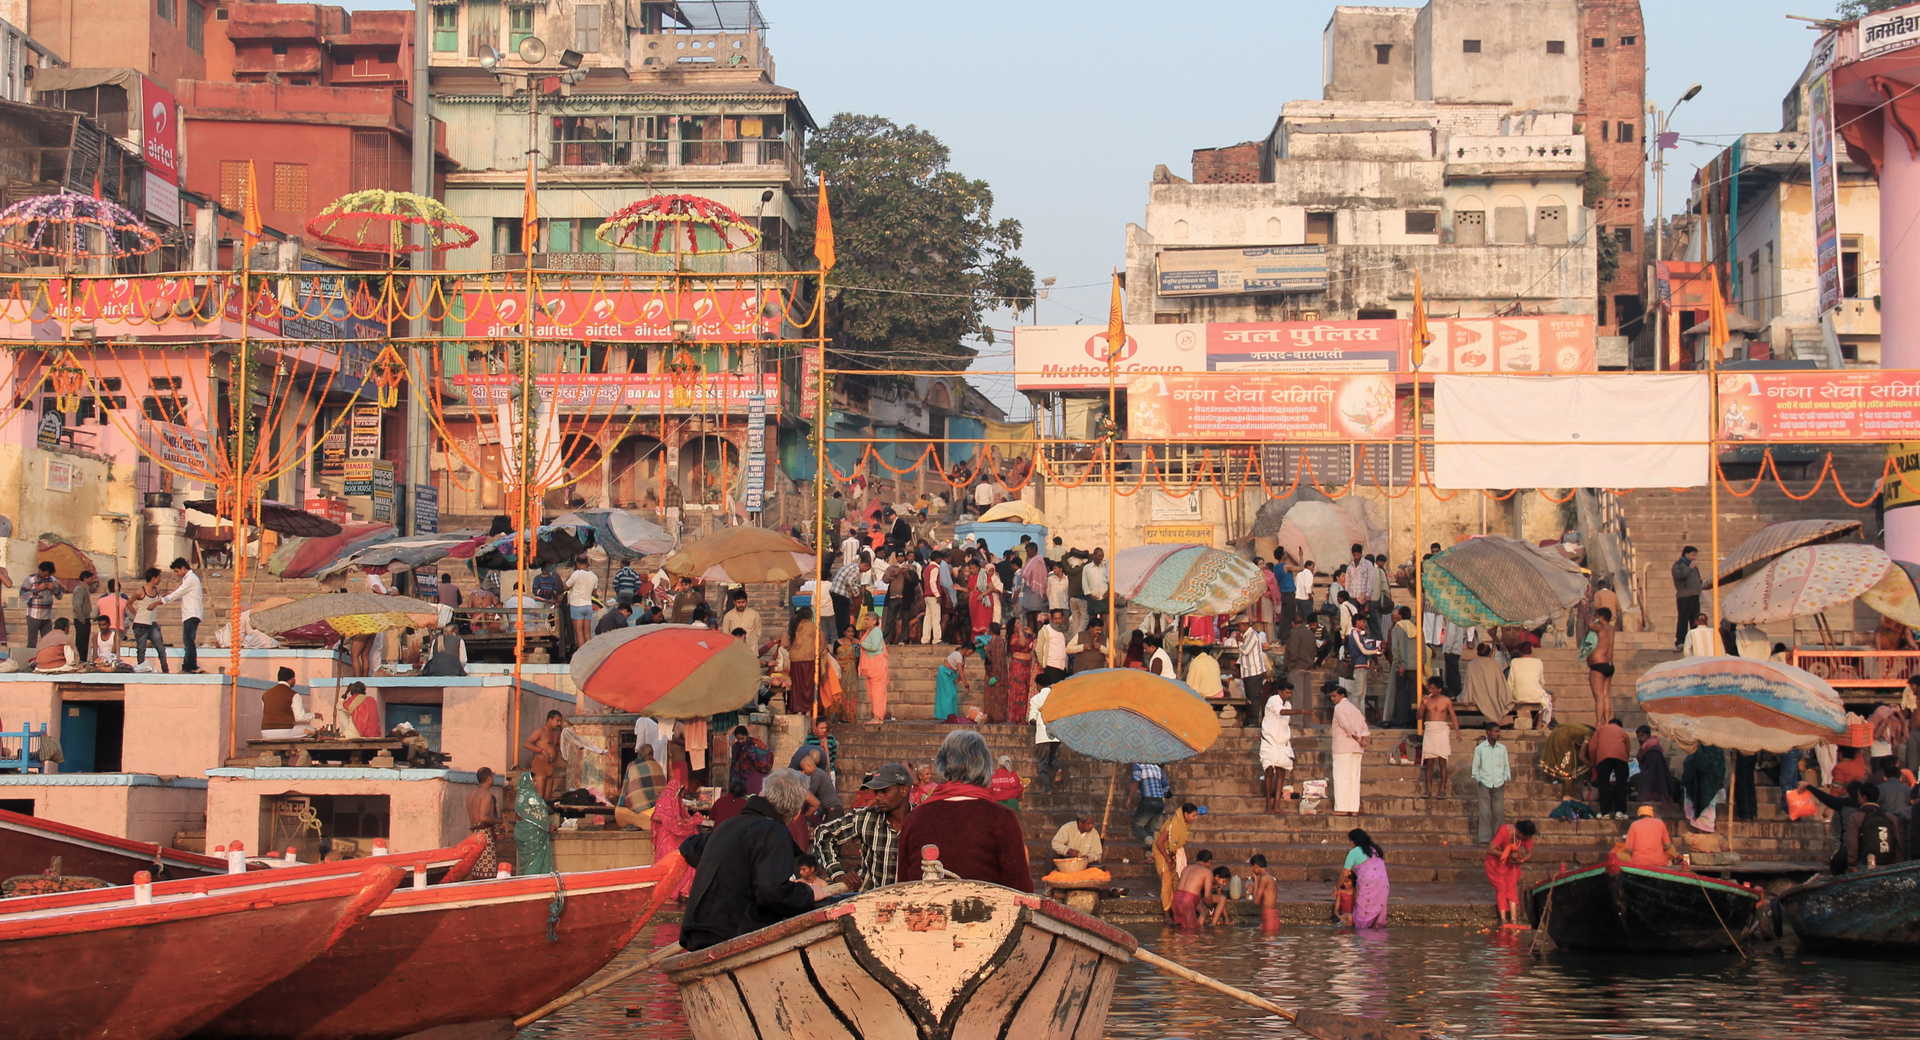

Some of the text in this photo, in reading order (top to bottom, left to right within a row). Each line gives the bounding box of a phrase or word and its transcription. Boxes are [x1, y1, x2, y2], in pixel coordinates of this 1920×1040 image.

[148, 137, 175, 168] airtel
[53, 302, 86, 316] airel
[487, 323, 523, 337] airel
[585, 323, 623, 337] airtel
[733, 322, 769, 335] airel
[1223, 324, 1382, 347] जल पुलिस
[1041, 363, 1184, 378] Muthoot Group
[1173, 384, 1336, 403] गंगा सेवा समिति
[1767, 382, 1814, 398] गंगा
[1820, 381, 1863, 399] सेवा
